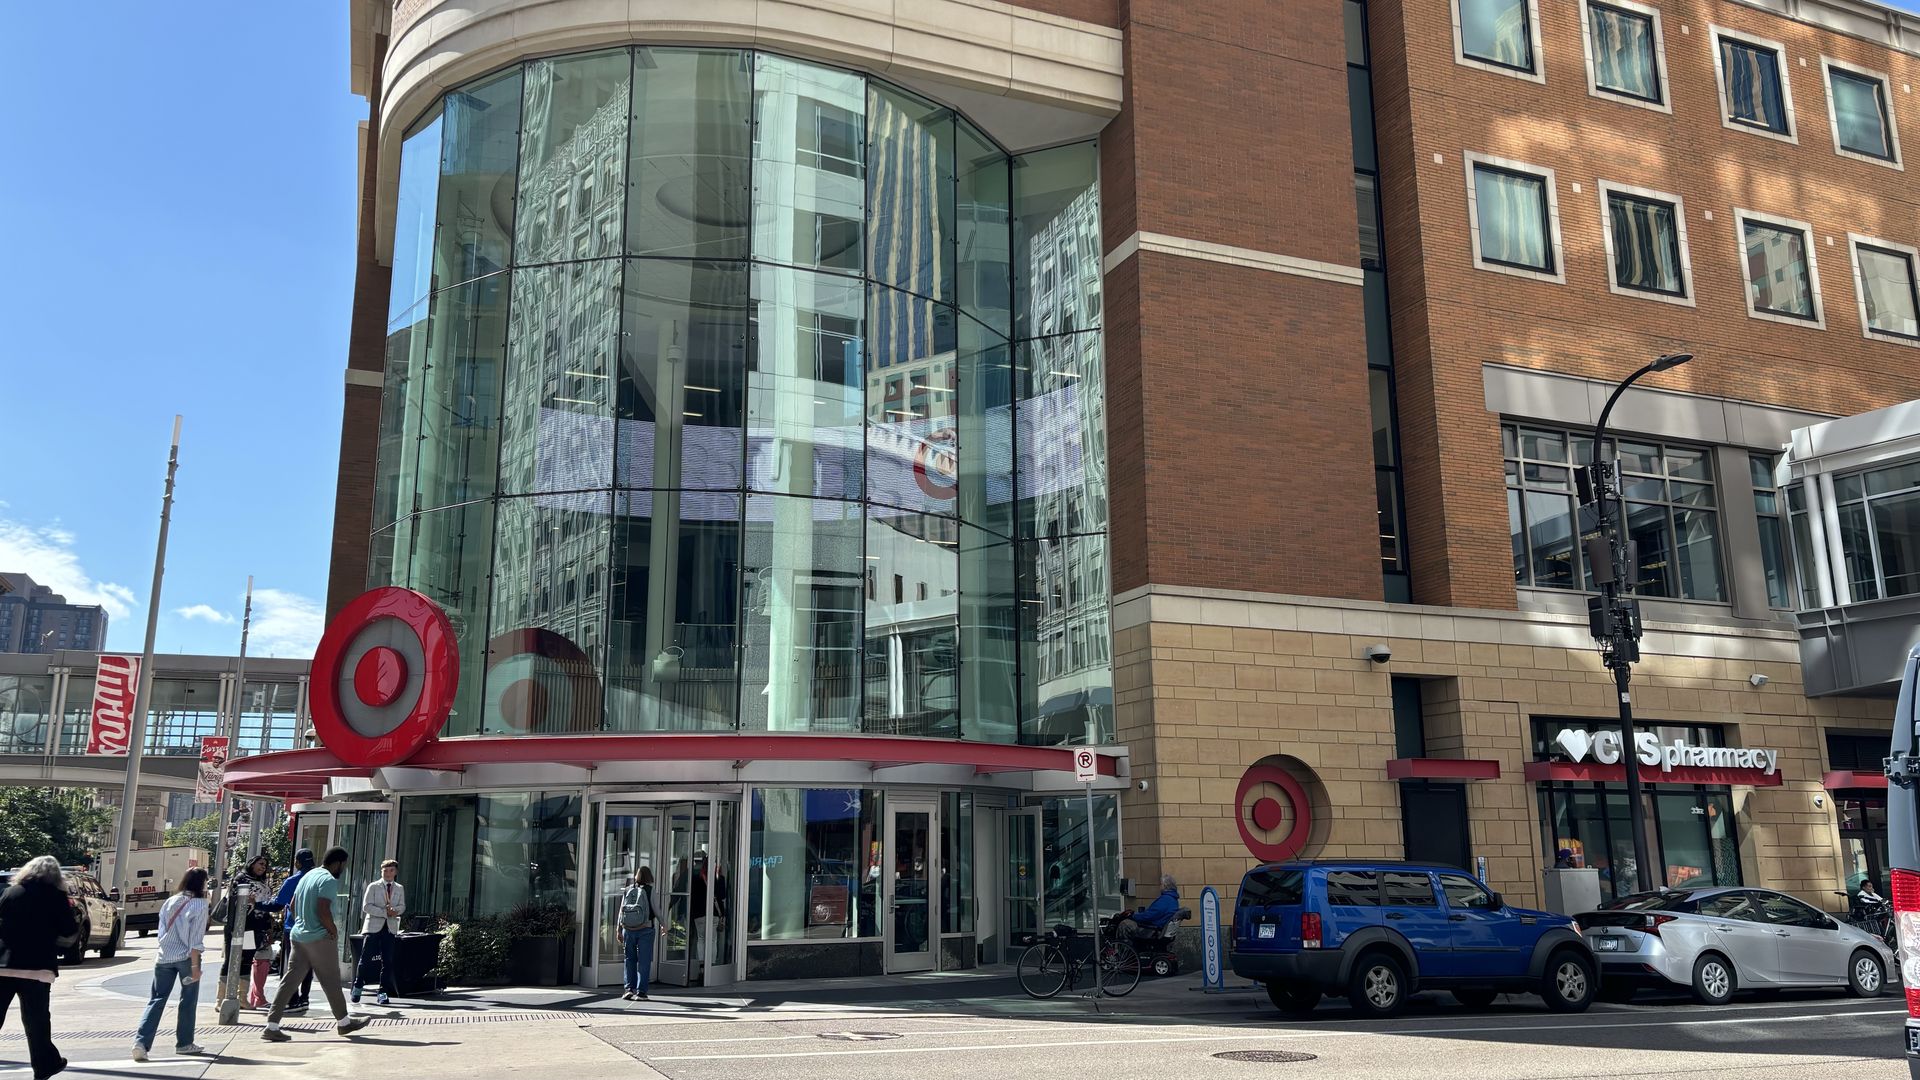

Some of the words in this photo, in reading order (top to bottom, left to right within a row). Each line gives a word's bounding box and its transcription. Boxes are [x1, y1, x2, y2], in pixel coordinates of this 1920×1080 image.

[95, 656, 137, 755] Twins
[201, 744, 228, 754] Correa
[1662, 739, 1777, 775] pharmacy
[133, 886, 156, 894] GARDA
